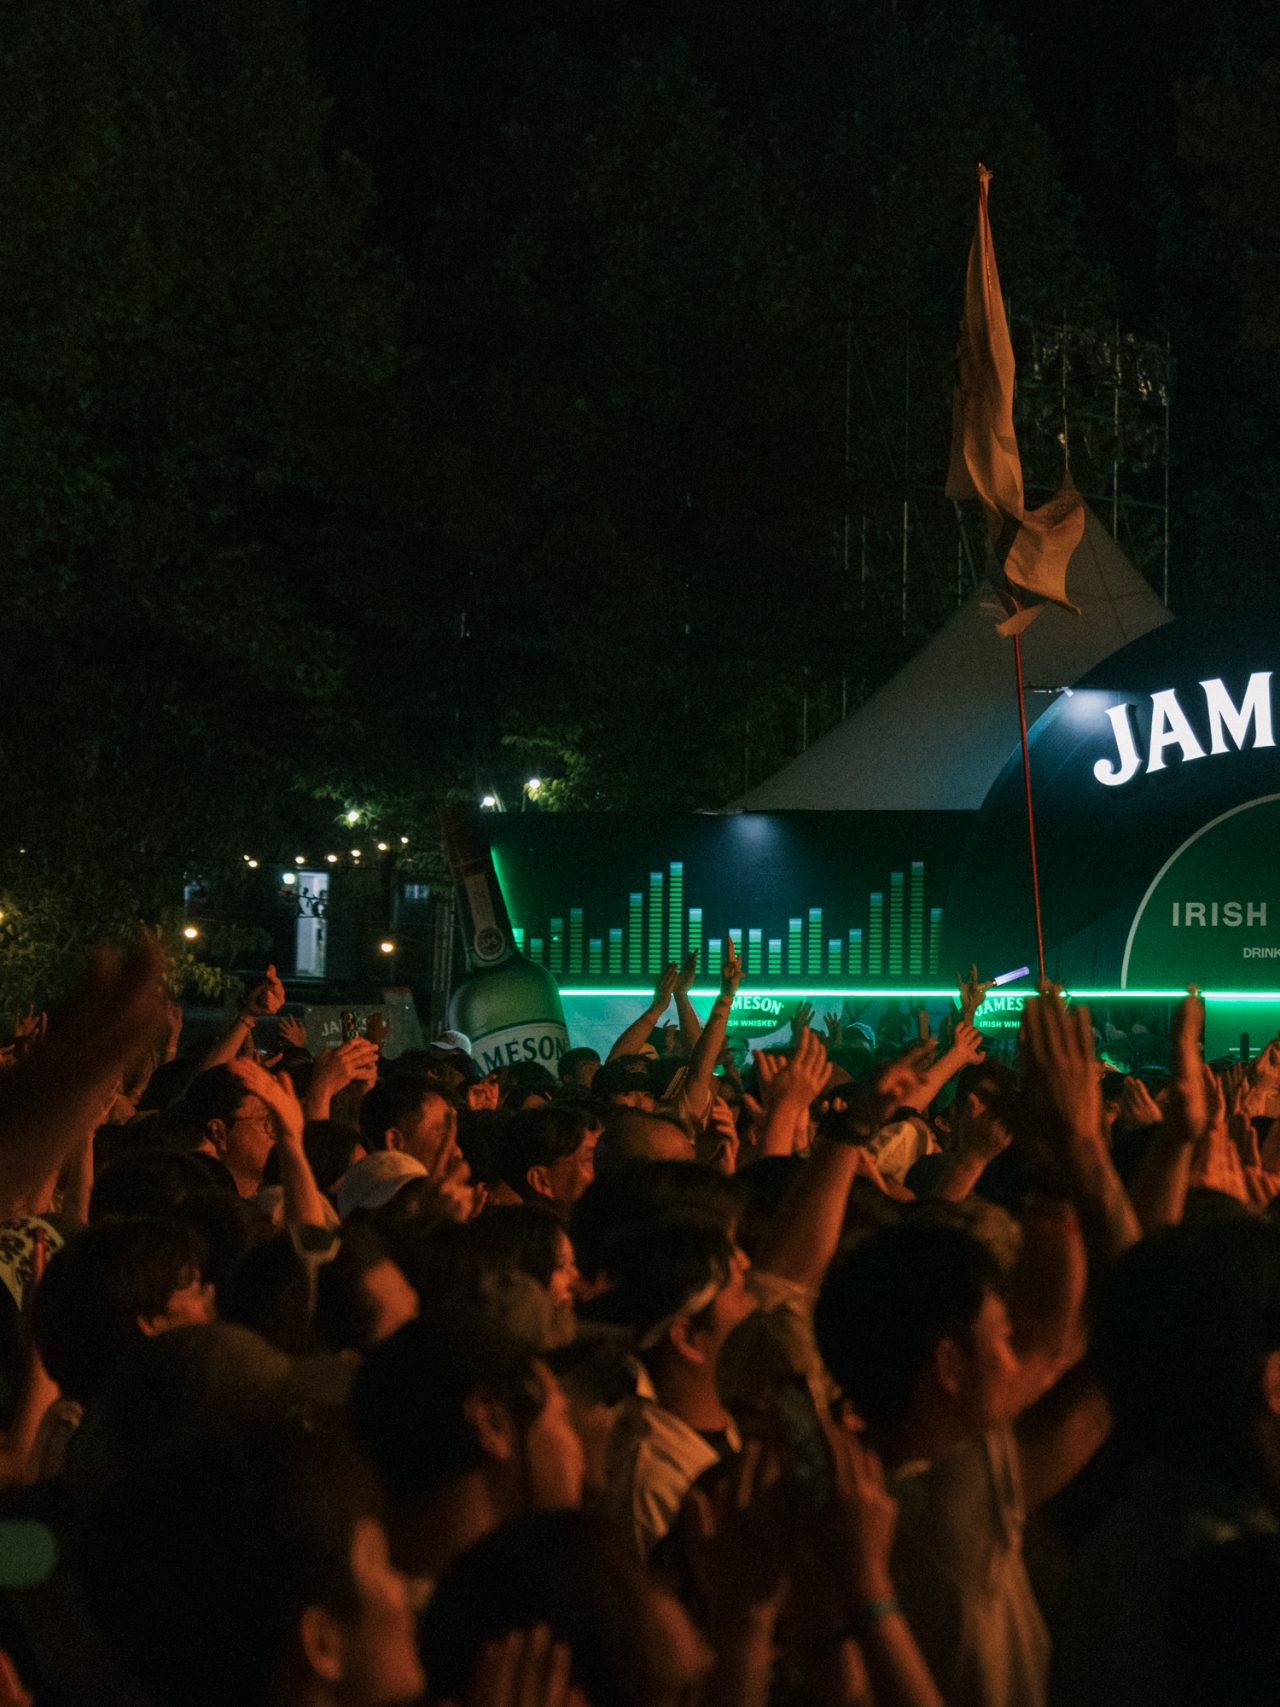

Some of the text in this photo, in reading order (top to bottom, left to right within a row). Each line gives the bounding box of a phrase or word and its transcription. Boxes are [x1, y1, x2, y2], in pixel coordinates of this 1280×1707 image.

[1171, 901, 1268, 927] IRISH
[731, 995, 783, 1016] MESON
[740, 1019, 778, 1027] WHISKEY
[979, 1020, 1001, 1028] IRISH
